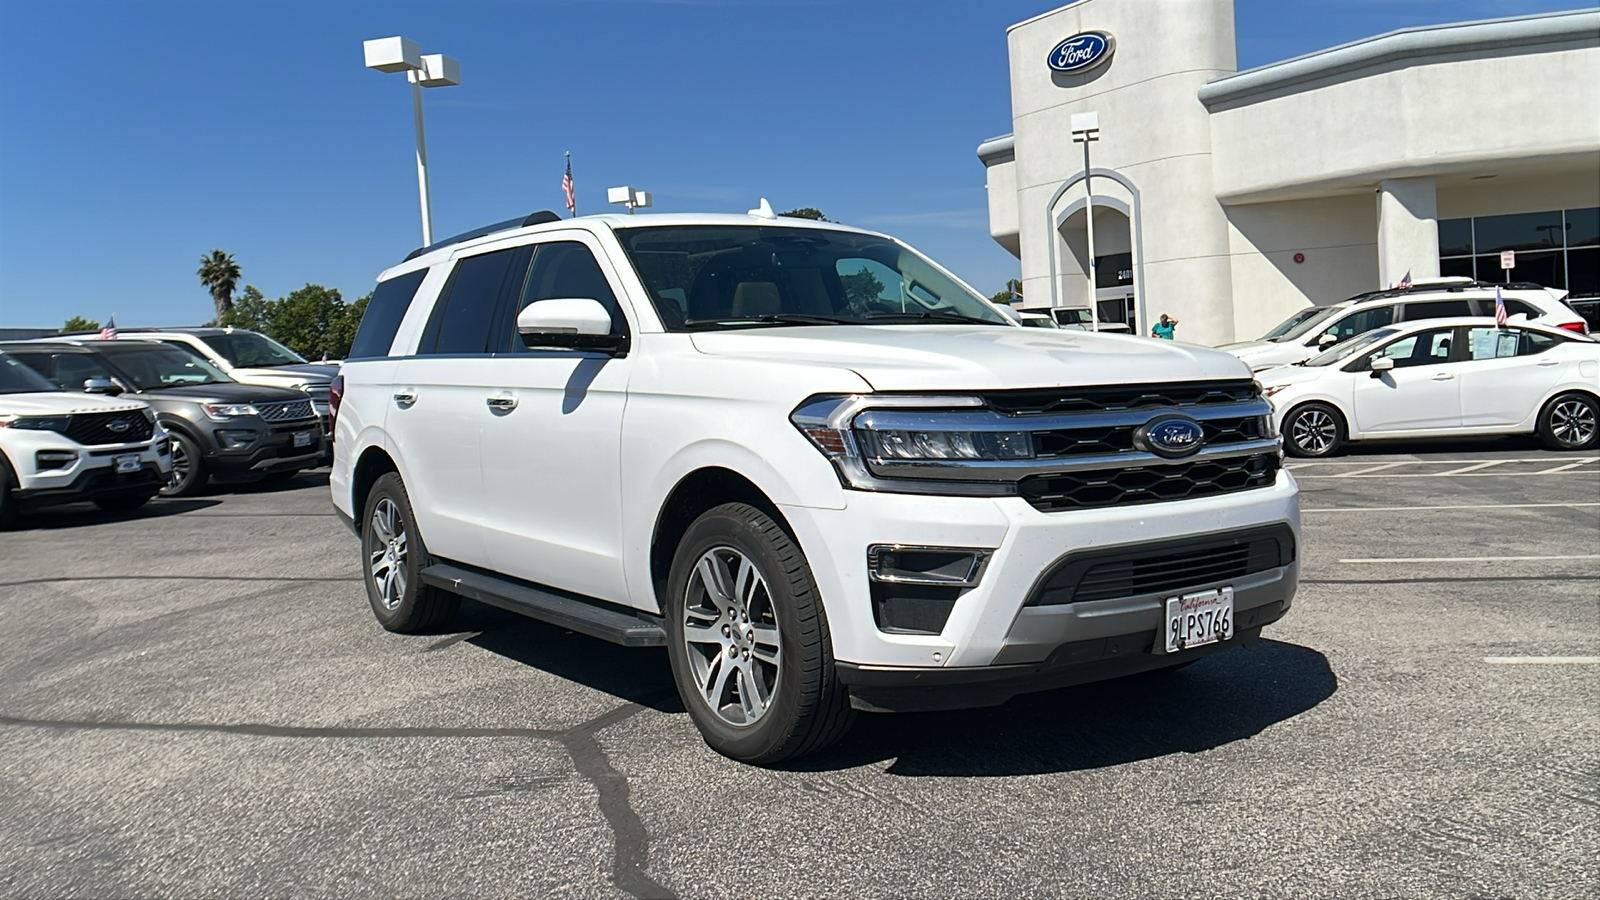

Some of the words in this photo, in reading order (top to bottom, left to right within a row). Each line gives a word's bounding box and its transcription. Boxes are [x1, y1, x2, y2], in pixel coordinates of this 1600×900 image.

[1058, 39, 1095, 67] Ford
[1163, 425, 1193, 444] Ford
[1180, 594, 1222, 613] California
[1171, 606, 1230, 645] 9LPS766
